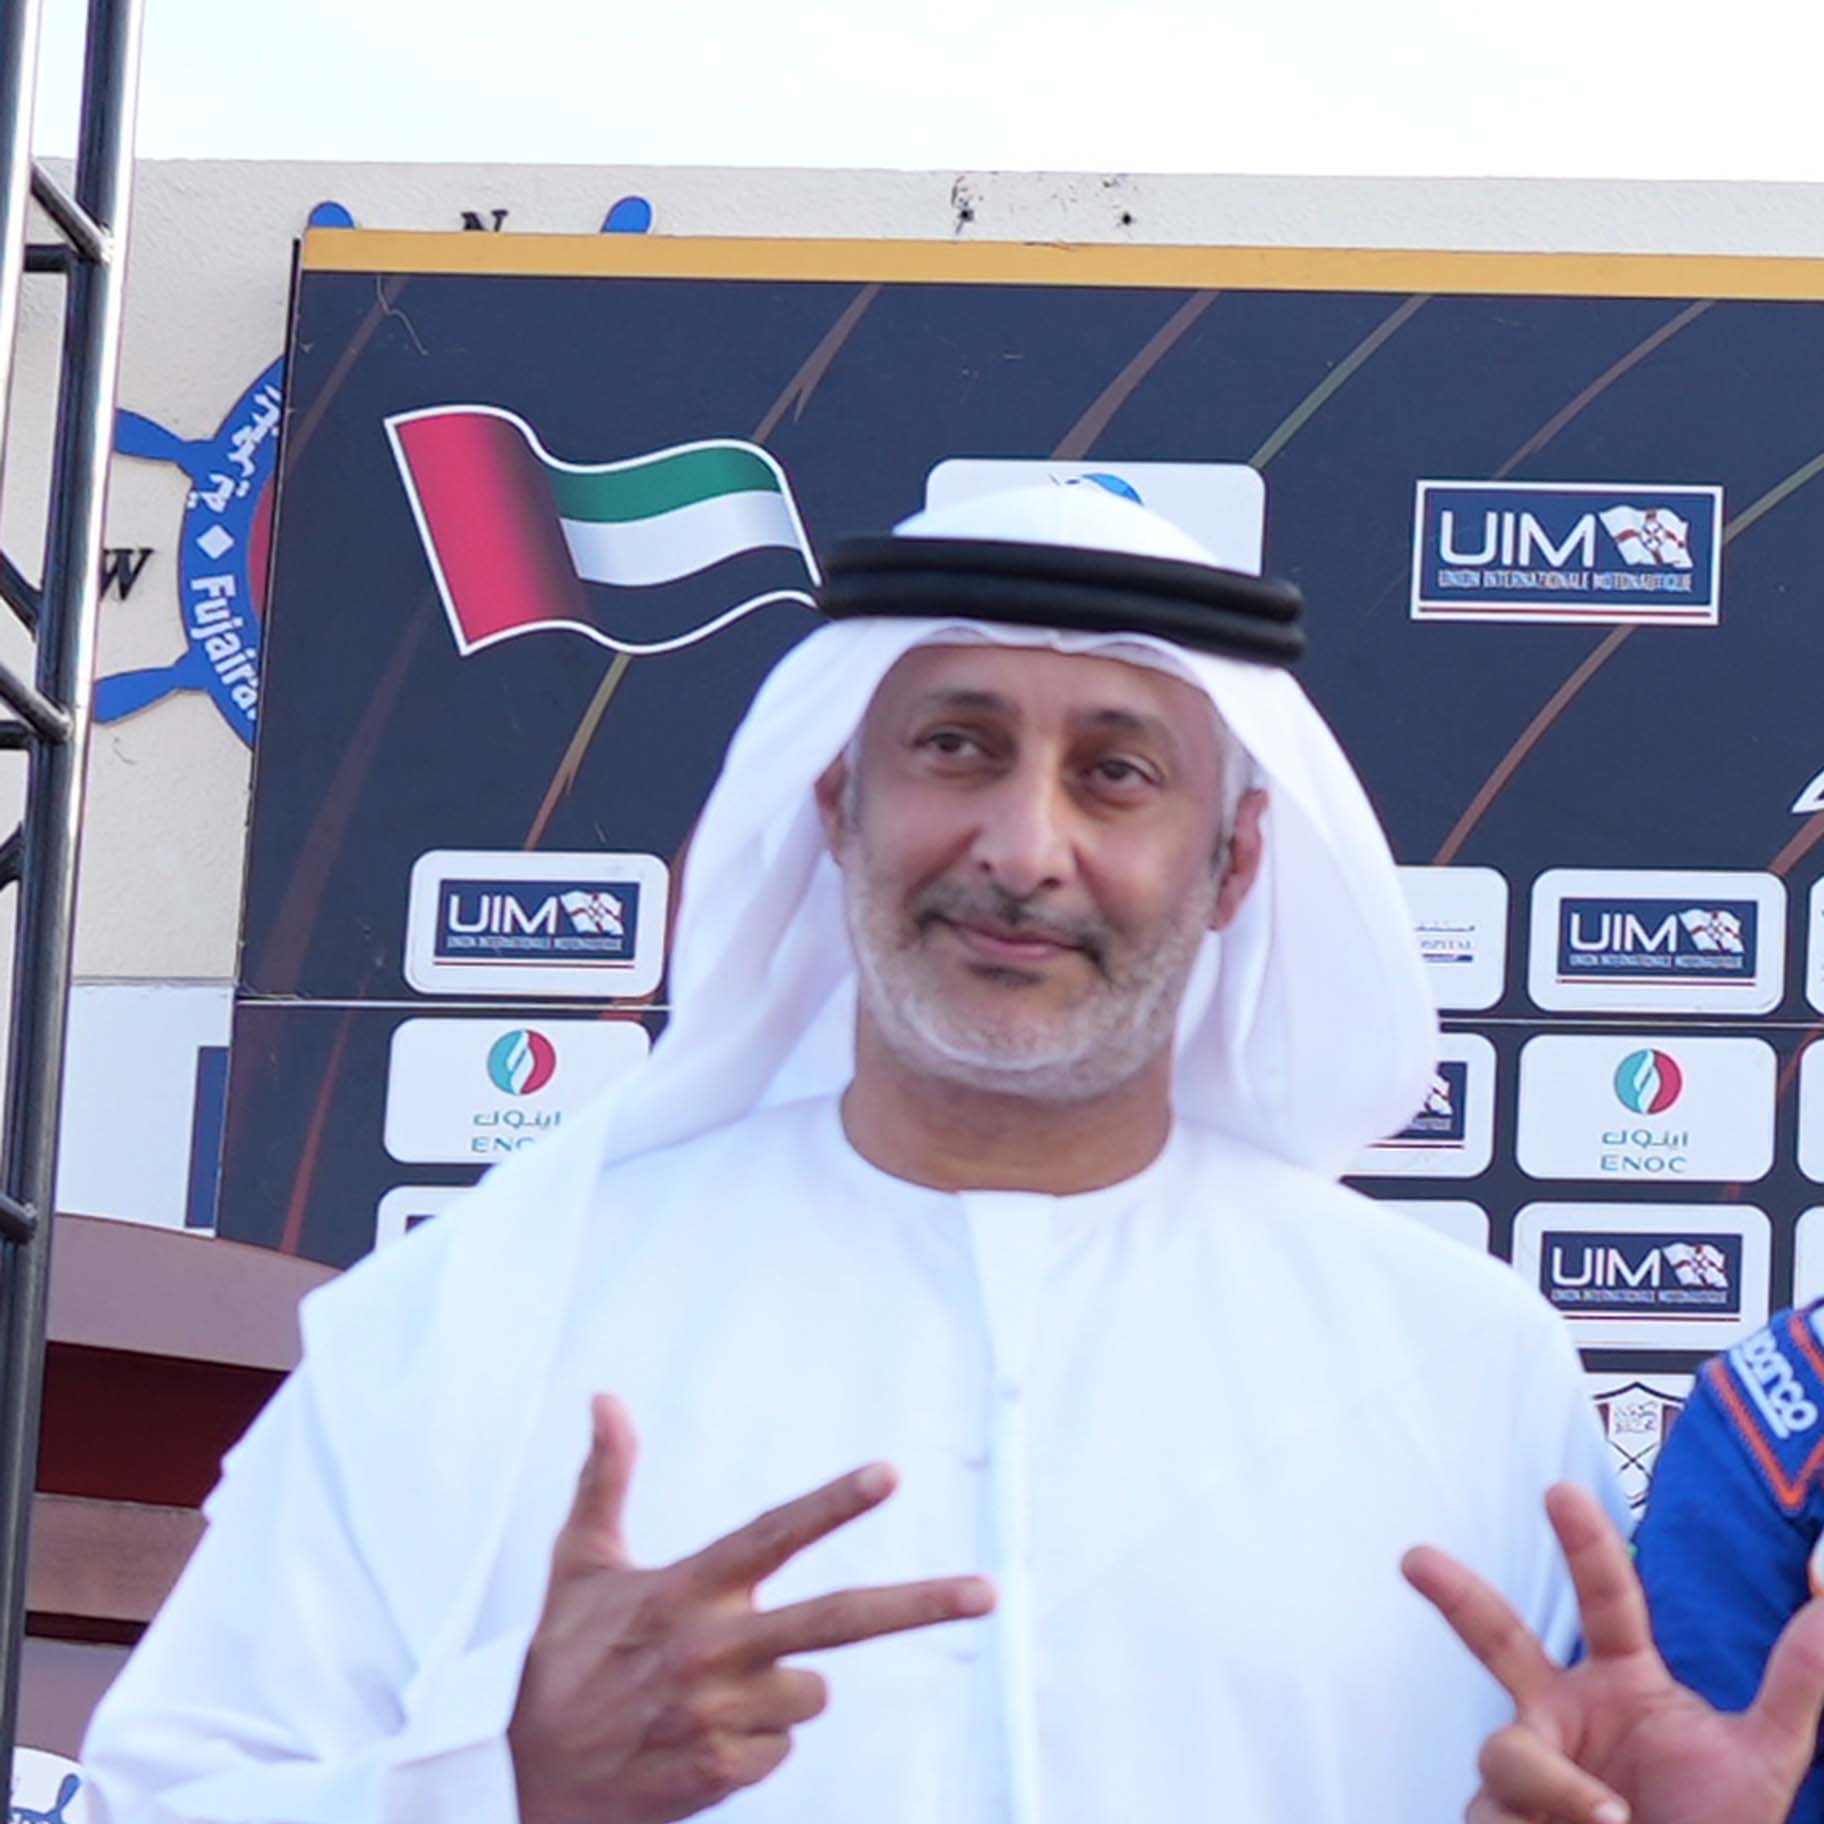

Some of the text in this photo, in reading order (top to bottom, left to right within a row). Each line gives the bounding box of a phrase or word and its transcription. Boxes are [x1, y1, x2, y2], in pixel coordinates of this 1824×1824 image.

[1440, 511, 1597, 567] UIM
[191, 574, 260, 720] Fujaira
[449, 894, 558, 934] UIM
[1570, 912, 1678, 953] UIM
[1599, 1154, 1688, 1173] ENOC
[1552, 1247, 1661, 1287] UIM
